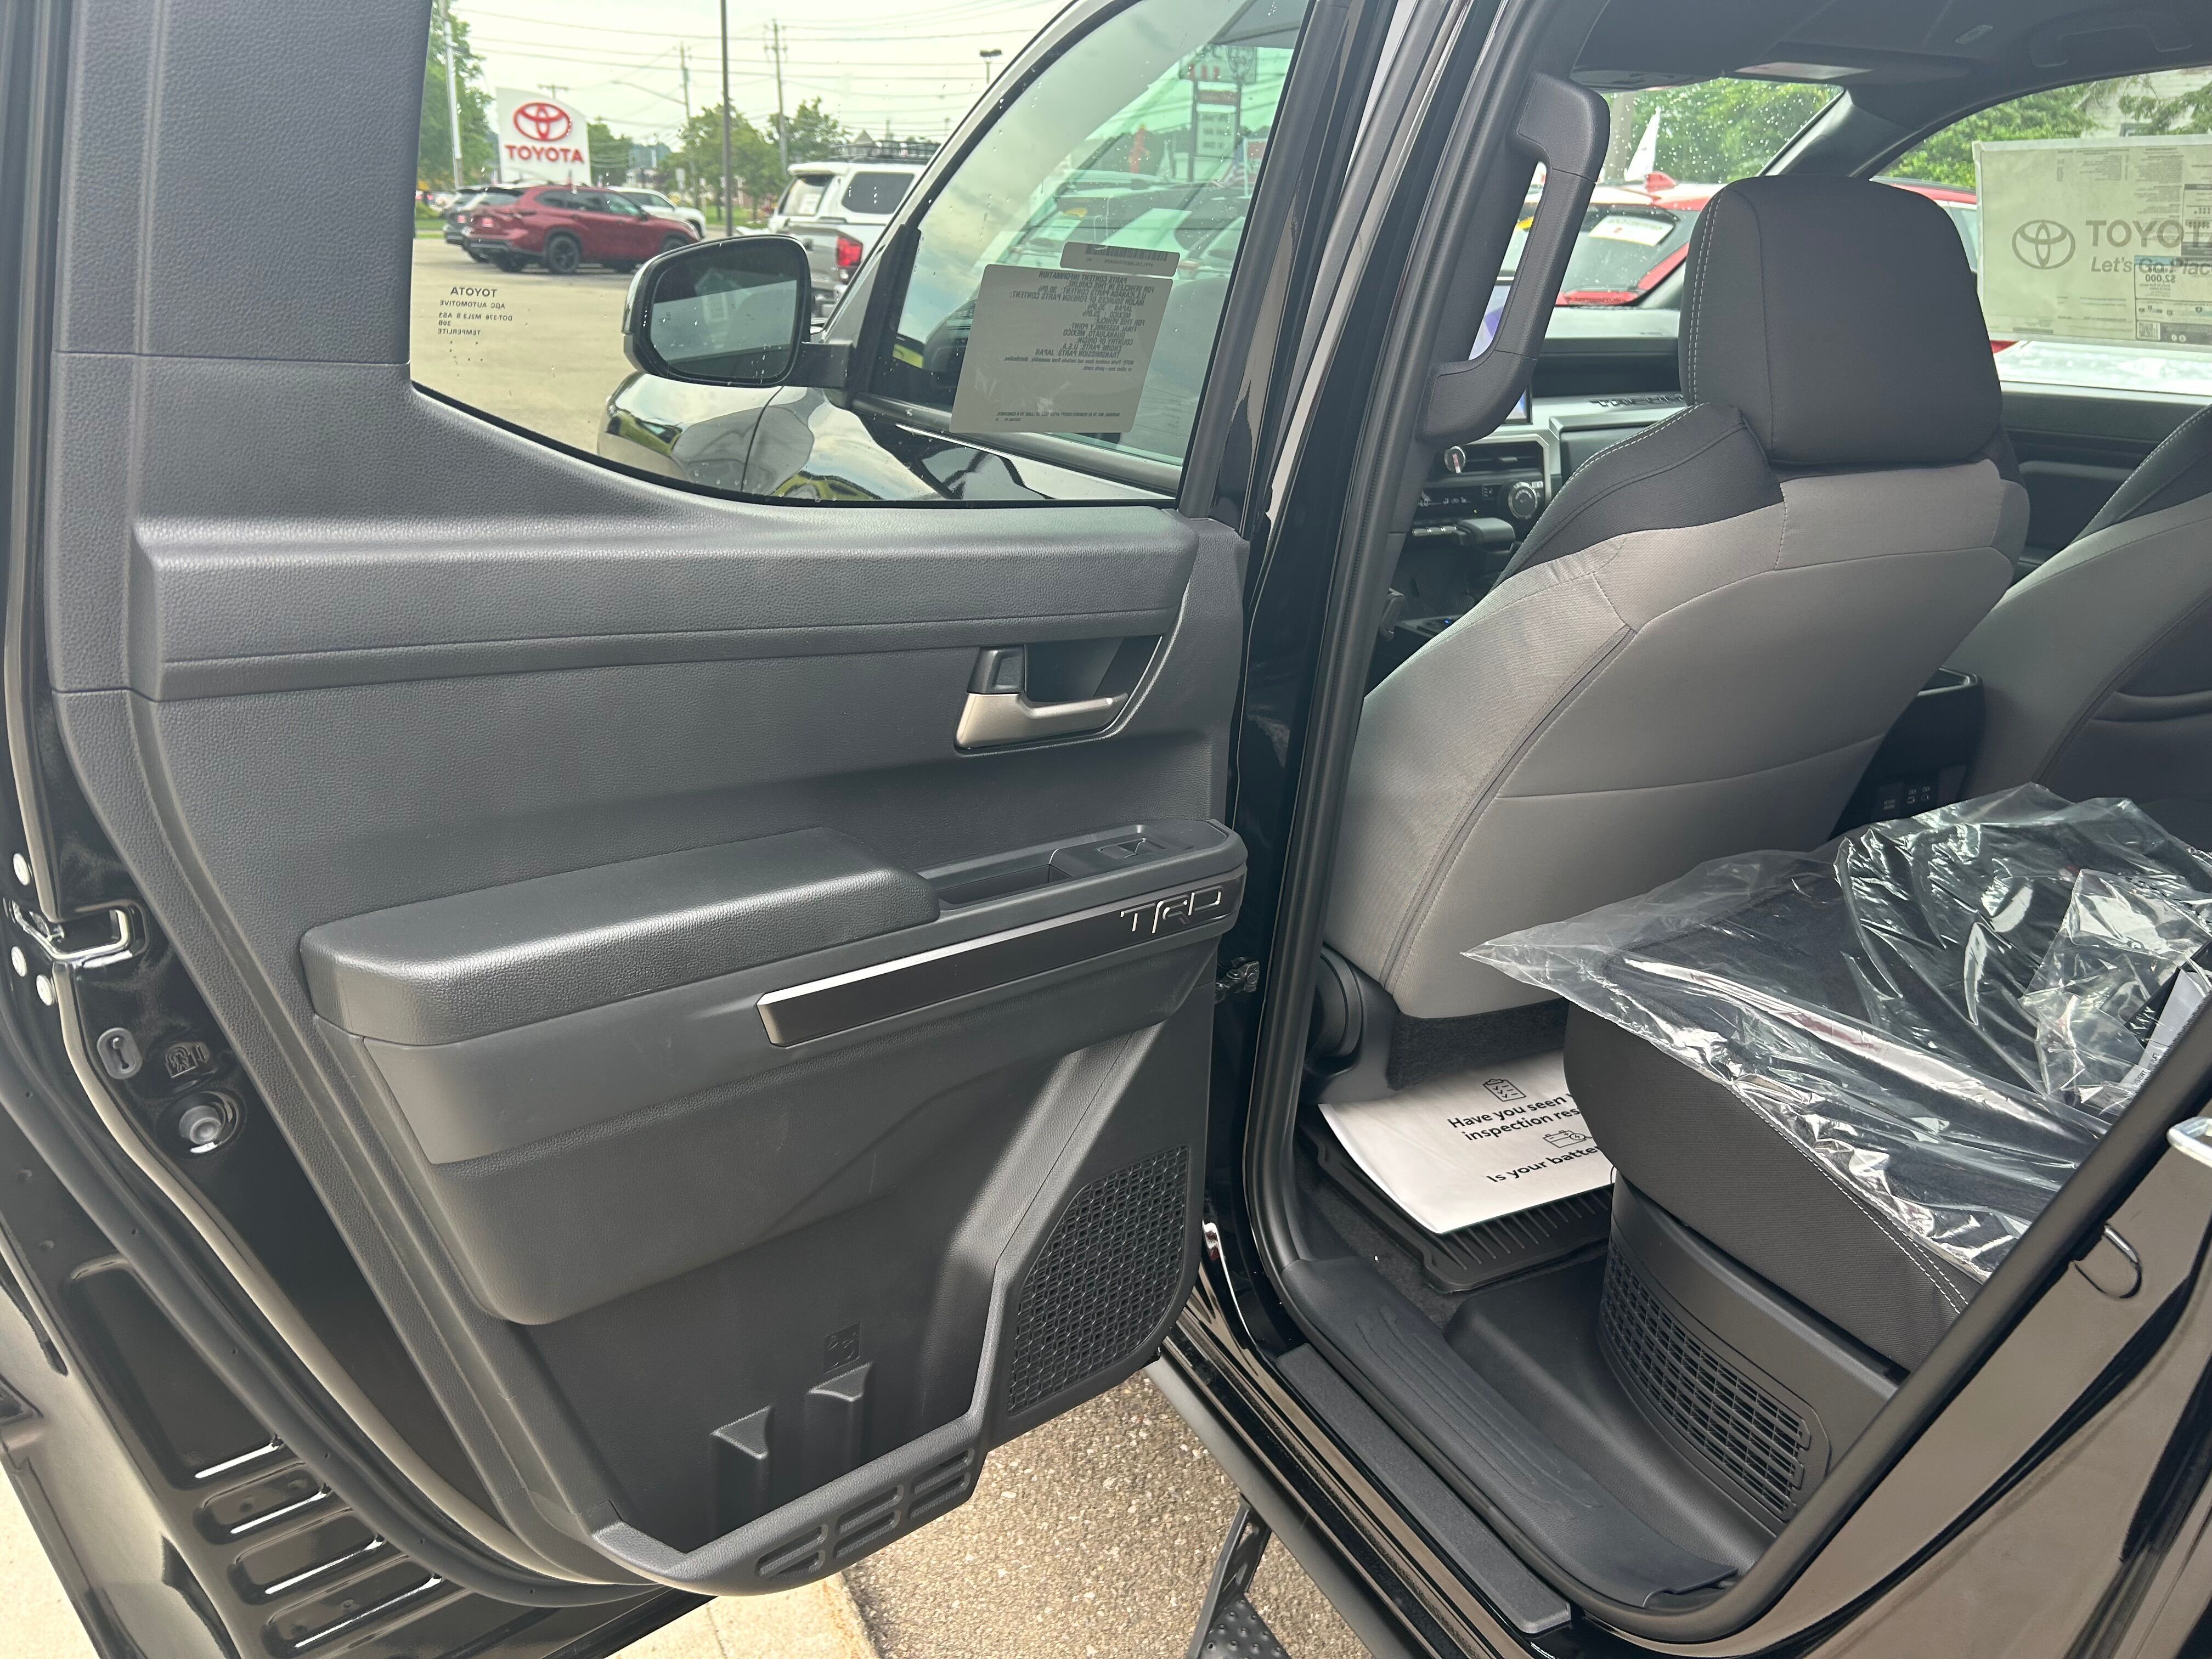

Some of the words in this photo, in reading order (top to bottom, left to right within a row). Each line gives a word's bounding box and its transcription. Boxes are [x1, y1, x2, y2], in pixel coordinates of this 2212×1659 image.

[505, 145, 584, 163] TOYOTA
[2085, 219, 2212, 248] TOYOT
[2091, 256, 2133, 273] Let's
[2139, 257, 2165, 274] Go
[2171, 258, 2212, 275] Plac
[1120, 885, 1224, 934] TRD
[1447, 1113, 1493, 1128] Have
[1492, 1105, 1527, 1121] you
[1527, 1097, 1567, 1111] seen
[1462, 1114, 1554, 1141] inspection
[1485, 1174, 1506, 1183] Is
[1505, 1160, 1547, 1179] your
